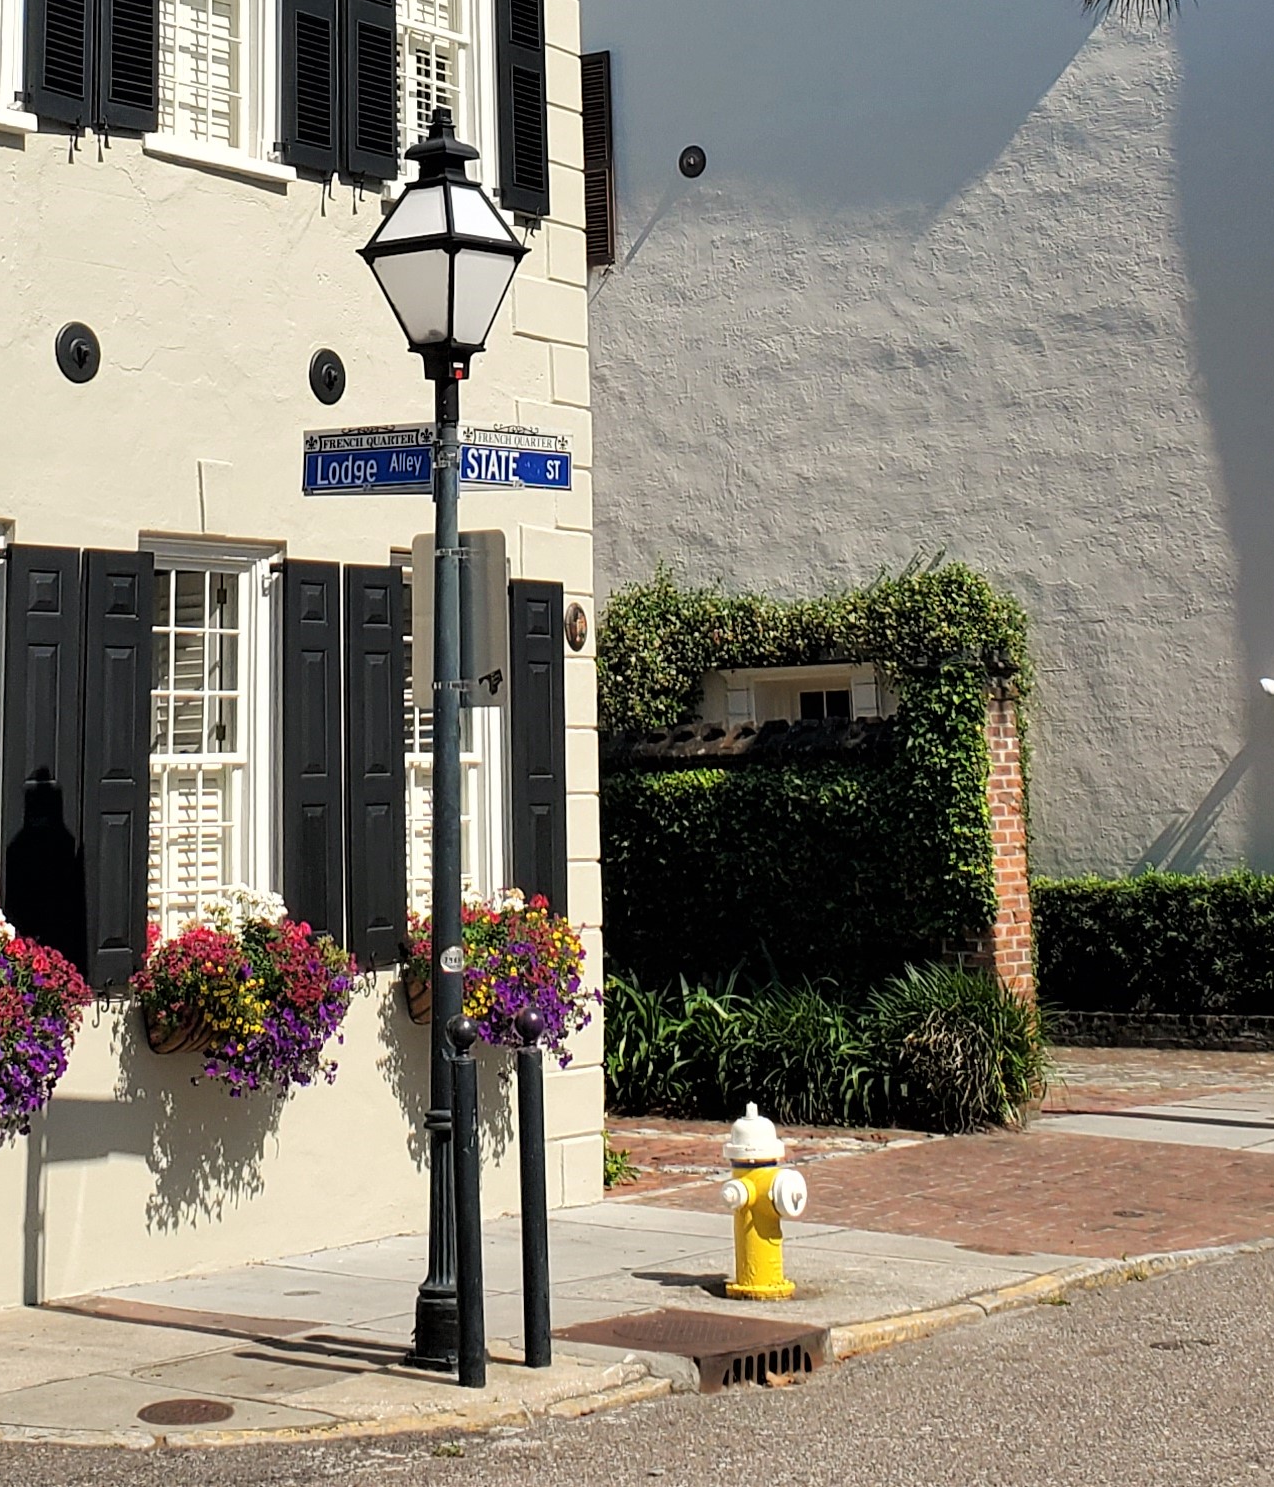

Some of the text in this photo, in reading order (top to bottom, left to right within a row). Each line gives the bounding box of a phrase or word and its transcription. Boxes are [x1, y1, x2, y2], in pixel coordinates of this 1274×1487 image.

[323, 433, 415, 450] FRENCH QUARTER
[477, 432, 553, 449] FRENCH QUARTER
[317, 452, 422, 484] Lodge Alley
[467, 448, 561, 481] STATE ST
